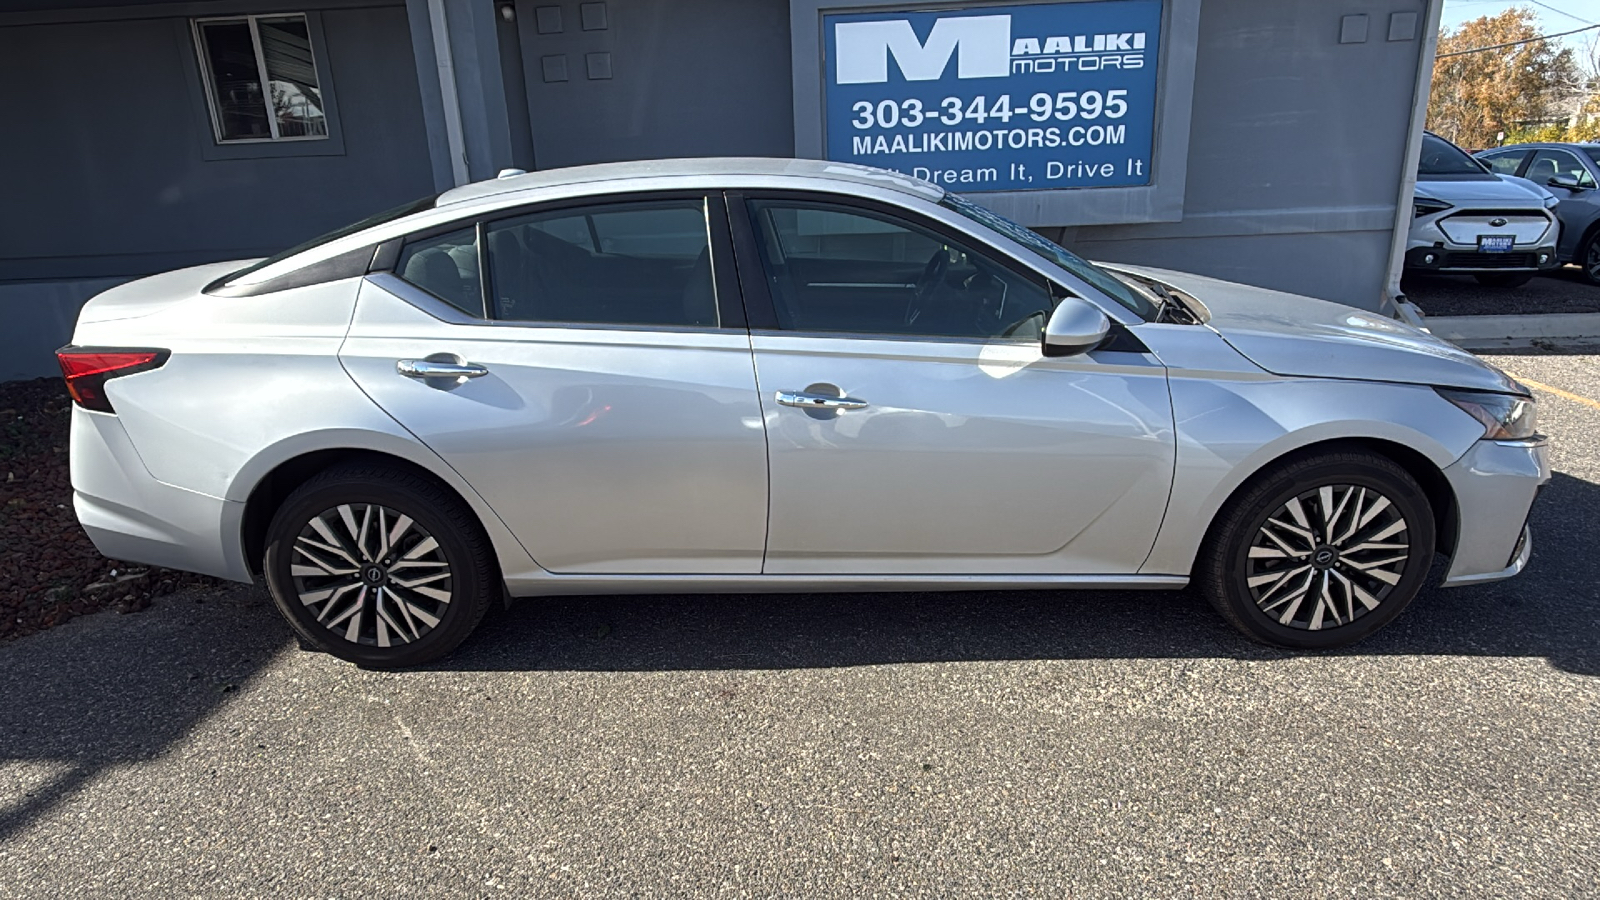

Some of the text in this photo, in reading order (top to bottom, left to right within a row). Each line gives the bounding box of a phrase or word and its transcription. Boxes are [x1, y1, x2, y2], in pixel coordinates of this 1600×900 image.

[1012, 54, 1144, 74] MOTORS
[851, 89, 1128, 129] 303-344-9595
[852, 125, 1126, 155] MAALIKIMOTORS.COM
[913, 158, 1143, 183] Dream It, Drive It
